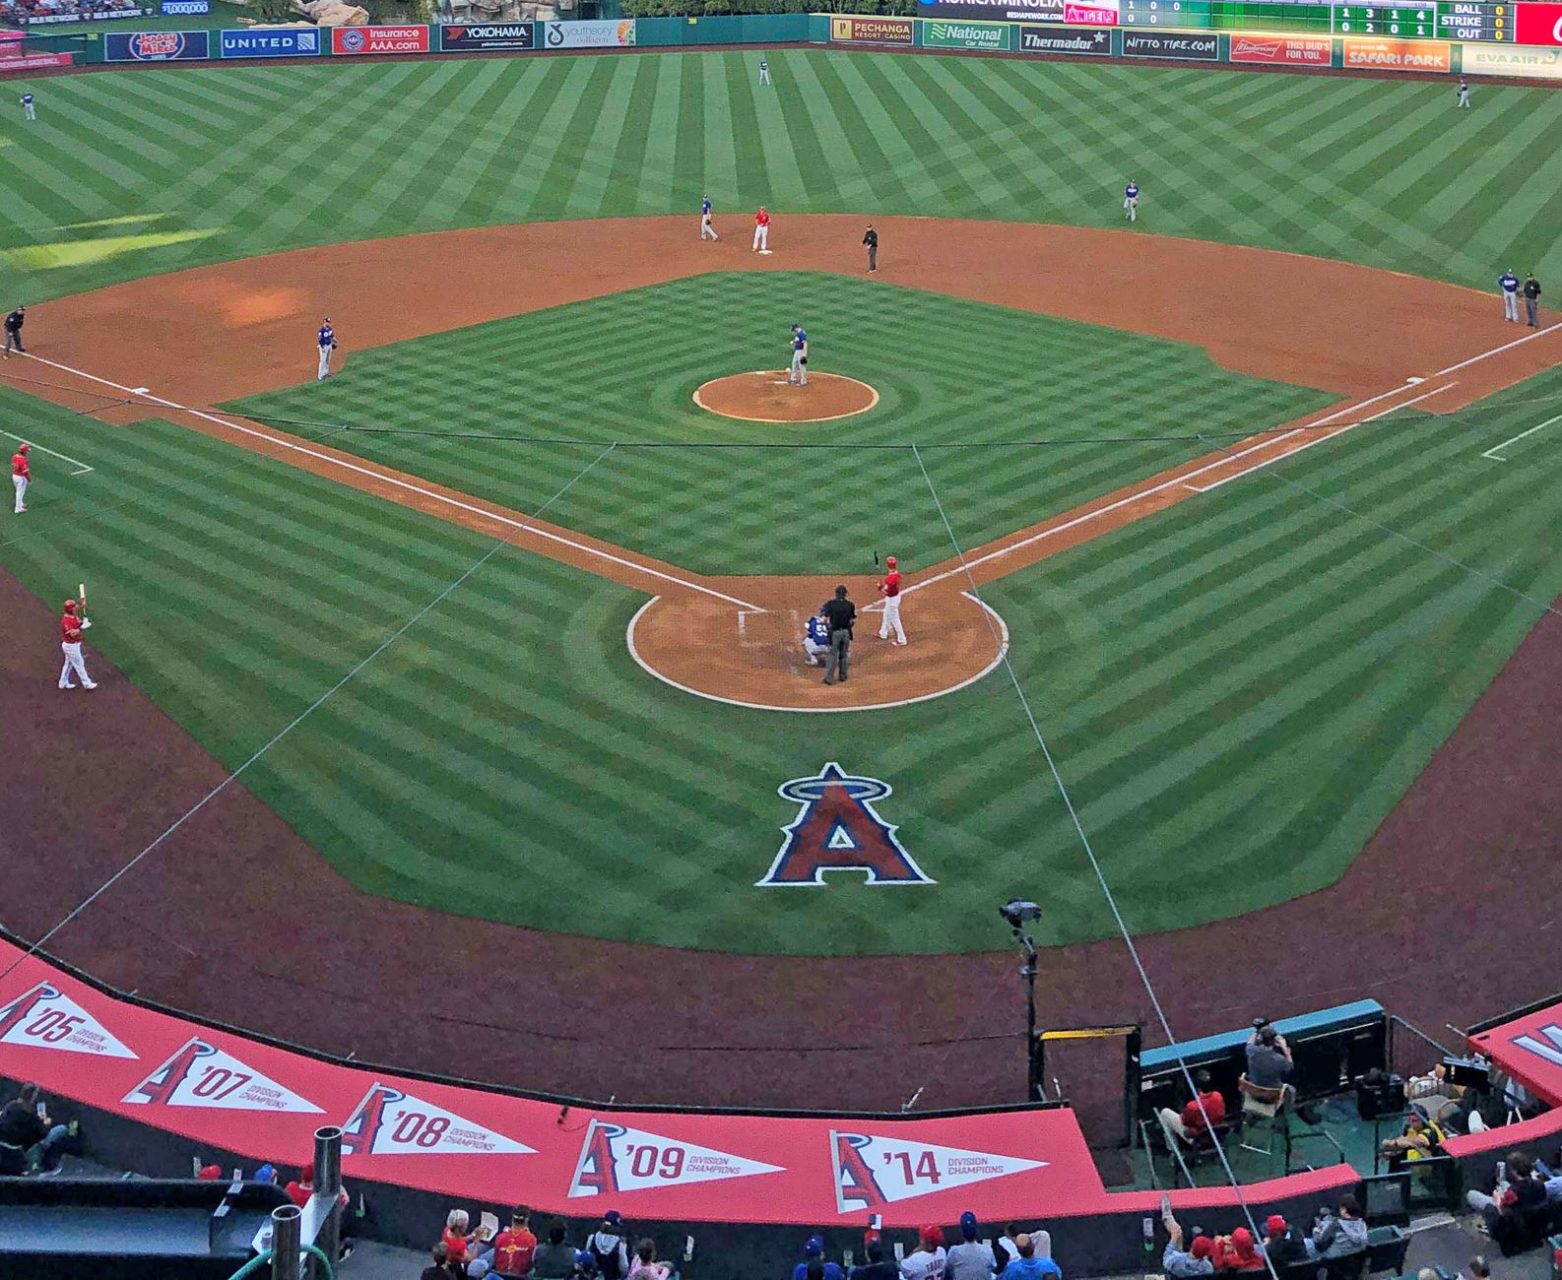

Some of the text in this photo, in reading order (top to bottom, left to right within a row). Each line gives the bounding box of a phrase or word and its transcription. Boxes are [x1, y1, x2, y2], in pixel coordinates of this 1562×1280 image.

[1006, 11, 1063, 20] RESHAPEWORK.COM
[1128, 1, 1425, 20] 1 0 0 1 3 1 4
[1455, 5, 1503, 15] BALL 0
[854, 23, 910, 34] PECHANGA
[1128, 14, 1425, 35] 0 0 0 2 0 1
[1441, 17, 1503, 28] STRIKE 0
[370, 30, 419, 38] Insurance
[467, 26, 526, 38] YOKOHAMA
[566, 26, 613, 37] youtheory
[946, 26, 1002, 41] National
[1457, 28, 1503, 40] OUT 0
[224, 38, 293, 49] UNITED
[369, 40, 420, 50] AAA.com
[1024, 34, 1092, 49] Thermador
[1126, 37, 1215, 52] NITTO TIRE.COM
[1286, 41, 1330, 51] THIS BUD'S
[1286, 50, 1321, 59] FOR YOU.
[1349, 52, 1444, 67] SAFARI PARK
[754, 762, 938, 886] A
[24, 1008, 86, 1043] '05
[192, 1066, 253, 1101] '07
[247, 1084, 284, 1098] DIVISION
[238, 1092, 288, 1109] CHAMPIONS
[392, 1111, 451, 1148] '08
[450, 1128, 488, 1141] DIVISION
[443, 1136, 496, 1151] CHAMPIONS
[625, 1144, 685, 1179] '09
[689, 1155, 730, 1165] DIVISION
[948, 1157, 989, 1167] DIVISION
[686, 1164, 742, 1175] CHAMPIONS
[883, 1151, 941, 1186] '14
[948, 1166, 1005, 1175] CHAMPIONS
